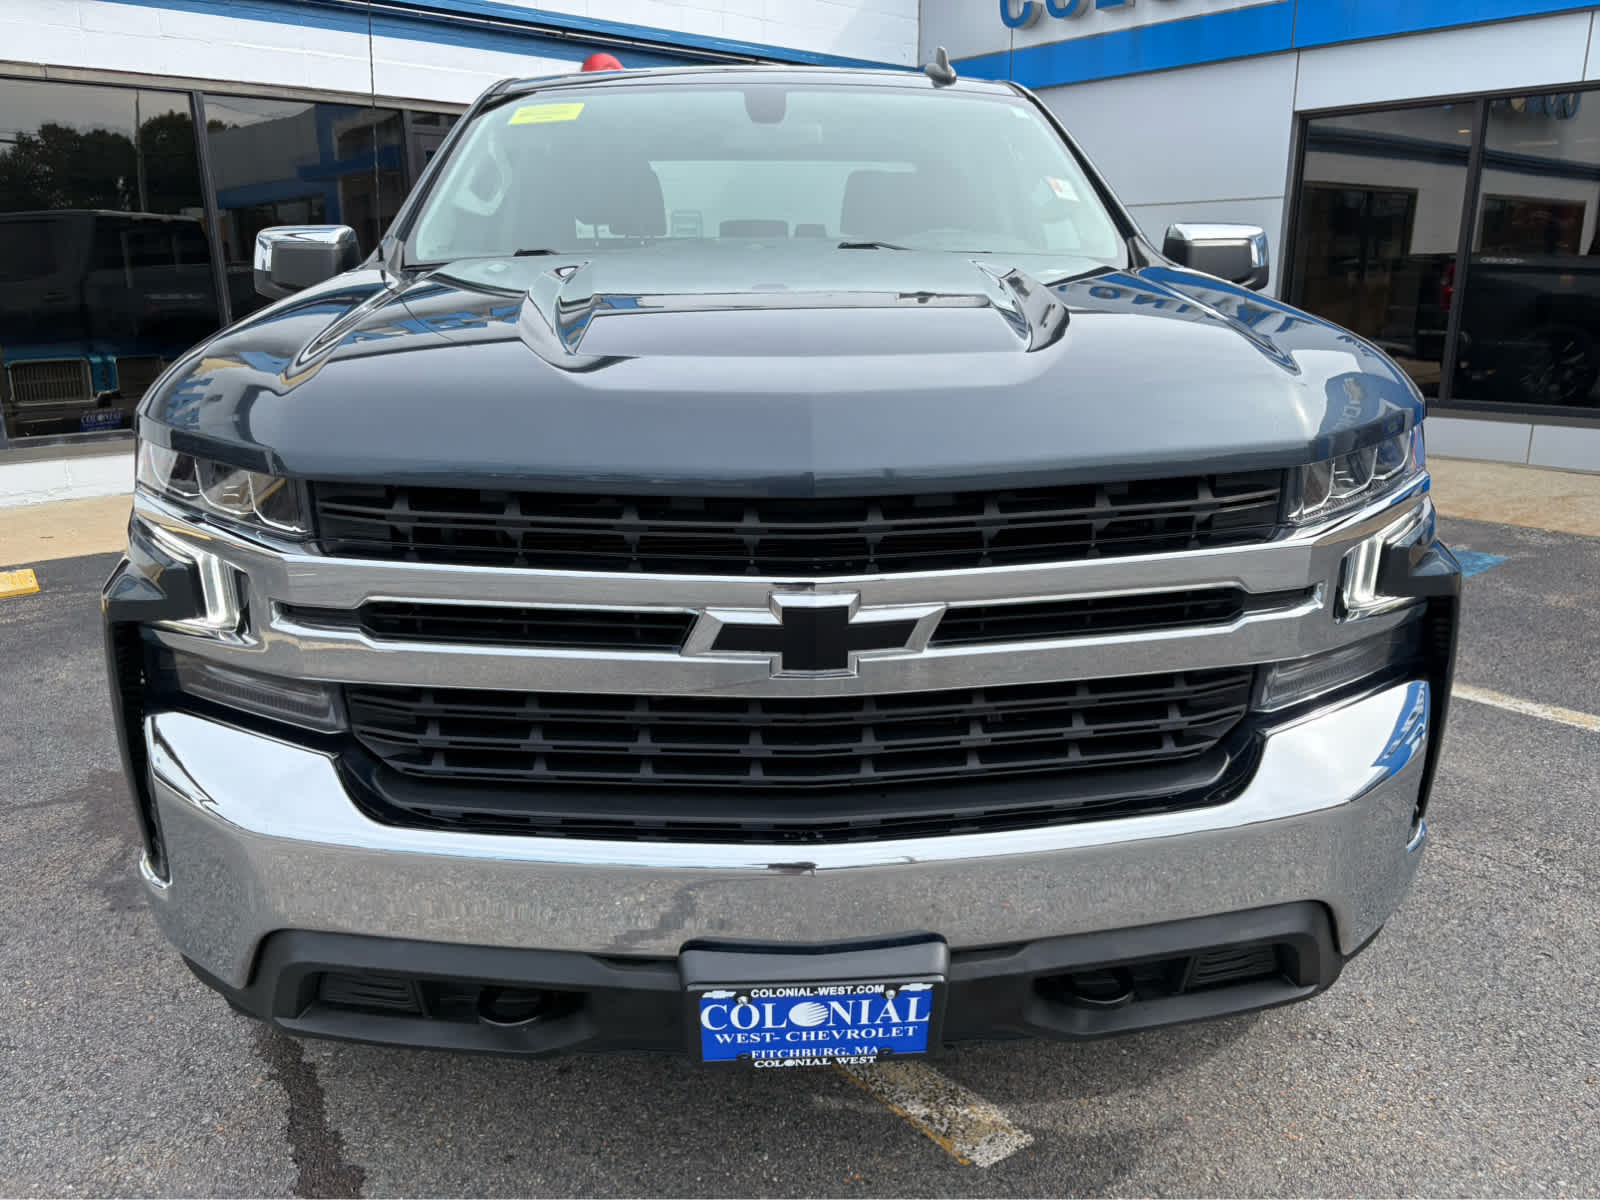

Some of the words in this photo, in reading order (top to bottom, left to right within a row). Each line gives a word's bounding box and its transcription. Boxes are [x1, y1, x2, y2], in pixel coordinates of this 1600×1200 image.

[750, 985, 885, 998] COLONIAL-WEST.COM
[700, 997, 931, 1030] COLONIAL
[785, 1026, 918, 1041] CHEVROLET
[854, 1046, 879, 1055] MA
[754, 1057, 831, 1068] COLONIAL
[835, 1056, 877, 1064] WEST
